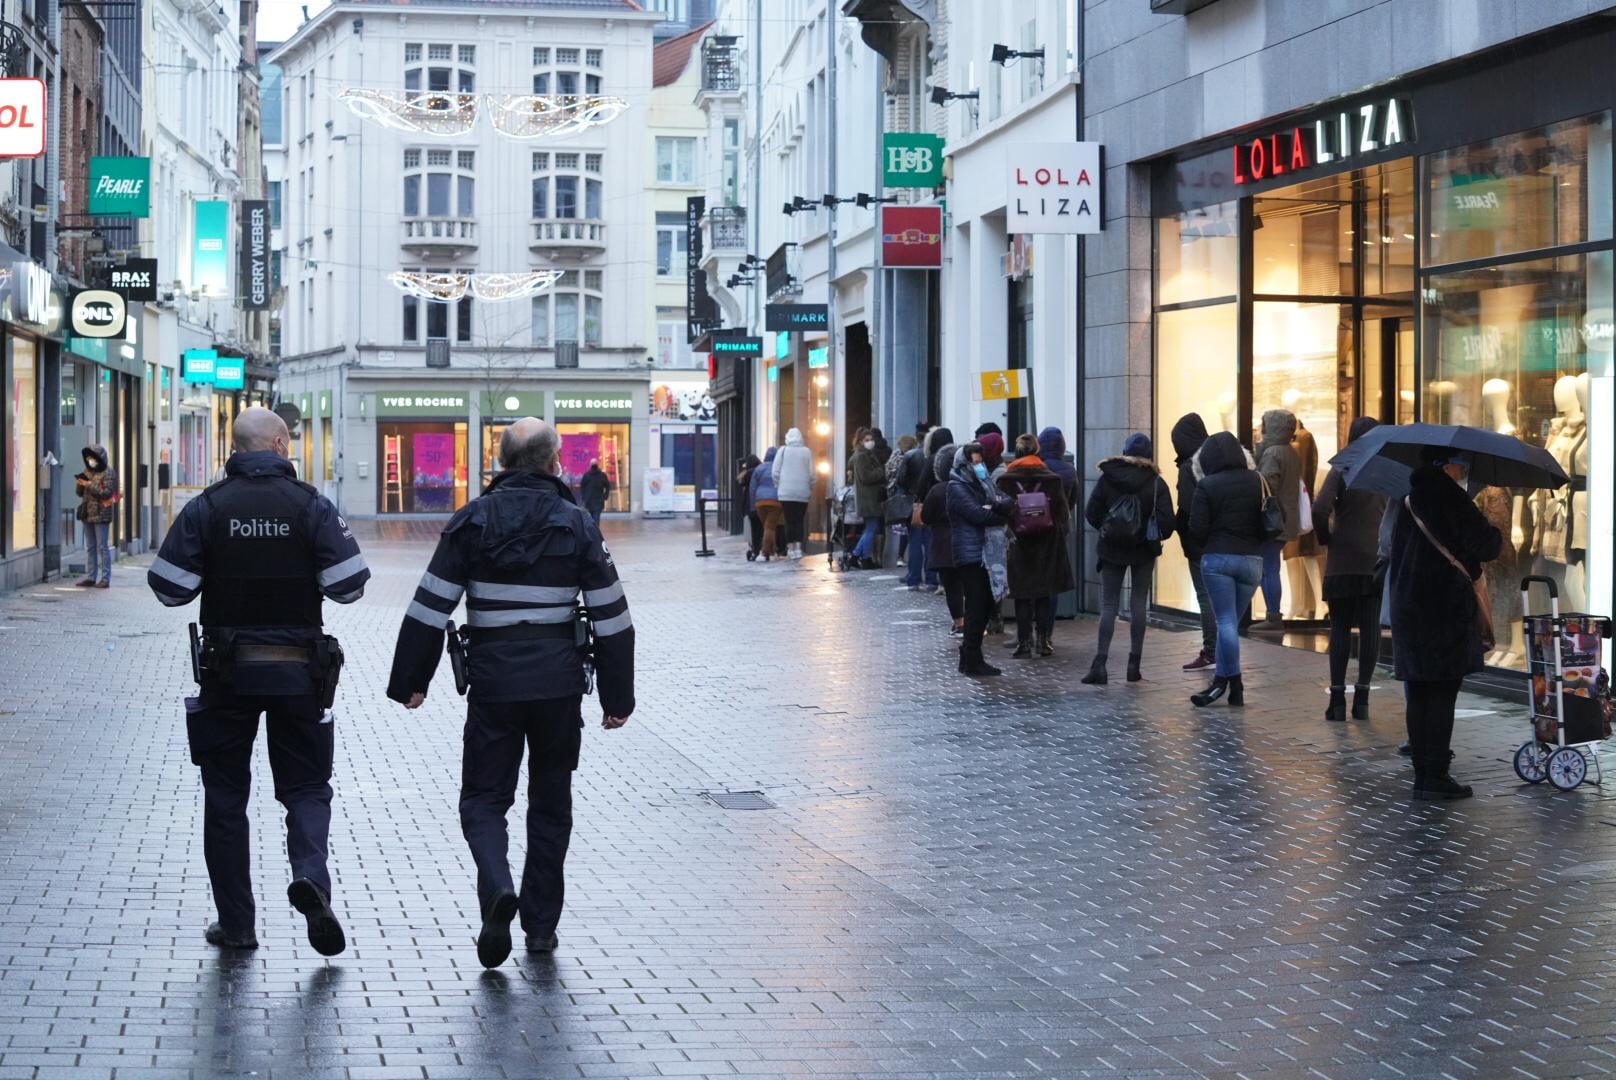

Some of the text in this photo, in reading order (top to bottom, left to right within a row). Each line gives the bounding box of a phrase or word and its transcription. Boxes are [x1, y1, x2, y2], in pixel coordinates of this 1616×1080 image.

[1232, 98, 1402, 185] LOLA LIZA
[1016, 168, 1091, 186] LOLA
[1016, 198, 1091, 216] LIZA
[251, 208, 265, 305] GERRY WEBER
[111, 271, 151, 283] BRAX
[77, 306, 120, 321] ONLY
[714, 342, 760, 352] PRIMARK
[382, 397, 464, 407] YVES ROCHER
[554, 399, 633, 409] YVES ROCHER
[229, 518, 290, 537] Politie
